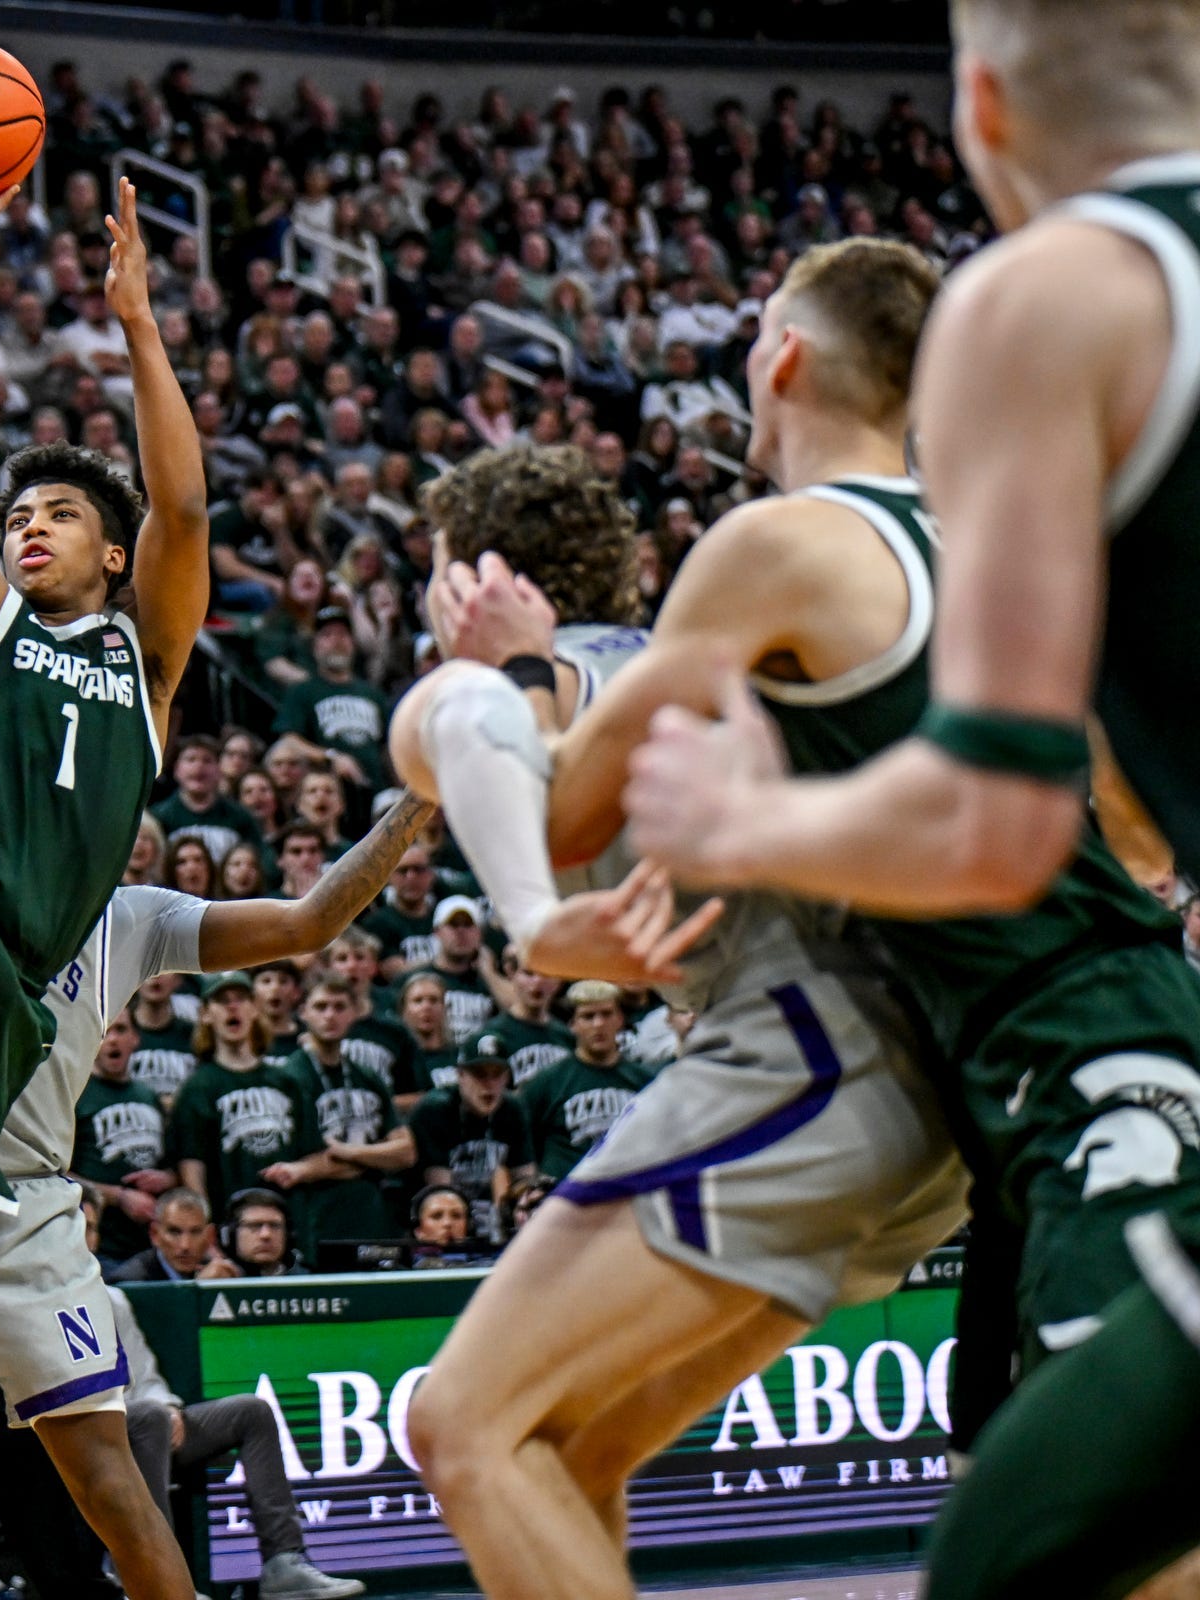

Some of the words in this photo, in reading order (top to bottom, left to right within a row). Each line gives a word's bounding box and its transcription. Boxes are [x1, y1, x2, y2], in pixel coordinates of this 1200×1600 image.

[55, 703, 80, 790] 1
[55, 1305, 103, 1362] N
[711, 1465, 806, 1496] LAW
[837, 1455, 949, 1487] FIRM
[226, 1500, 332, 1531] LW
